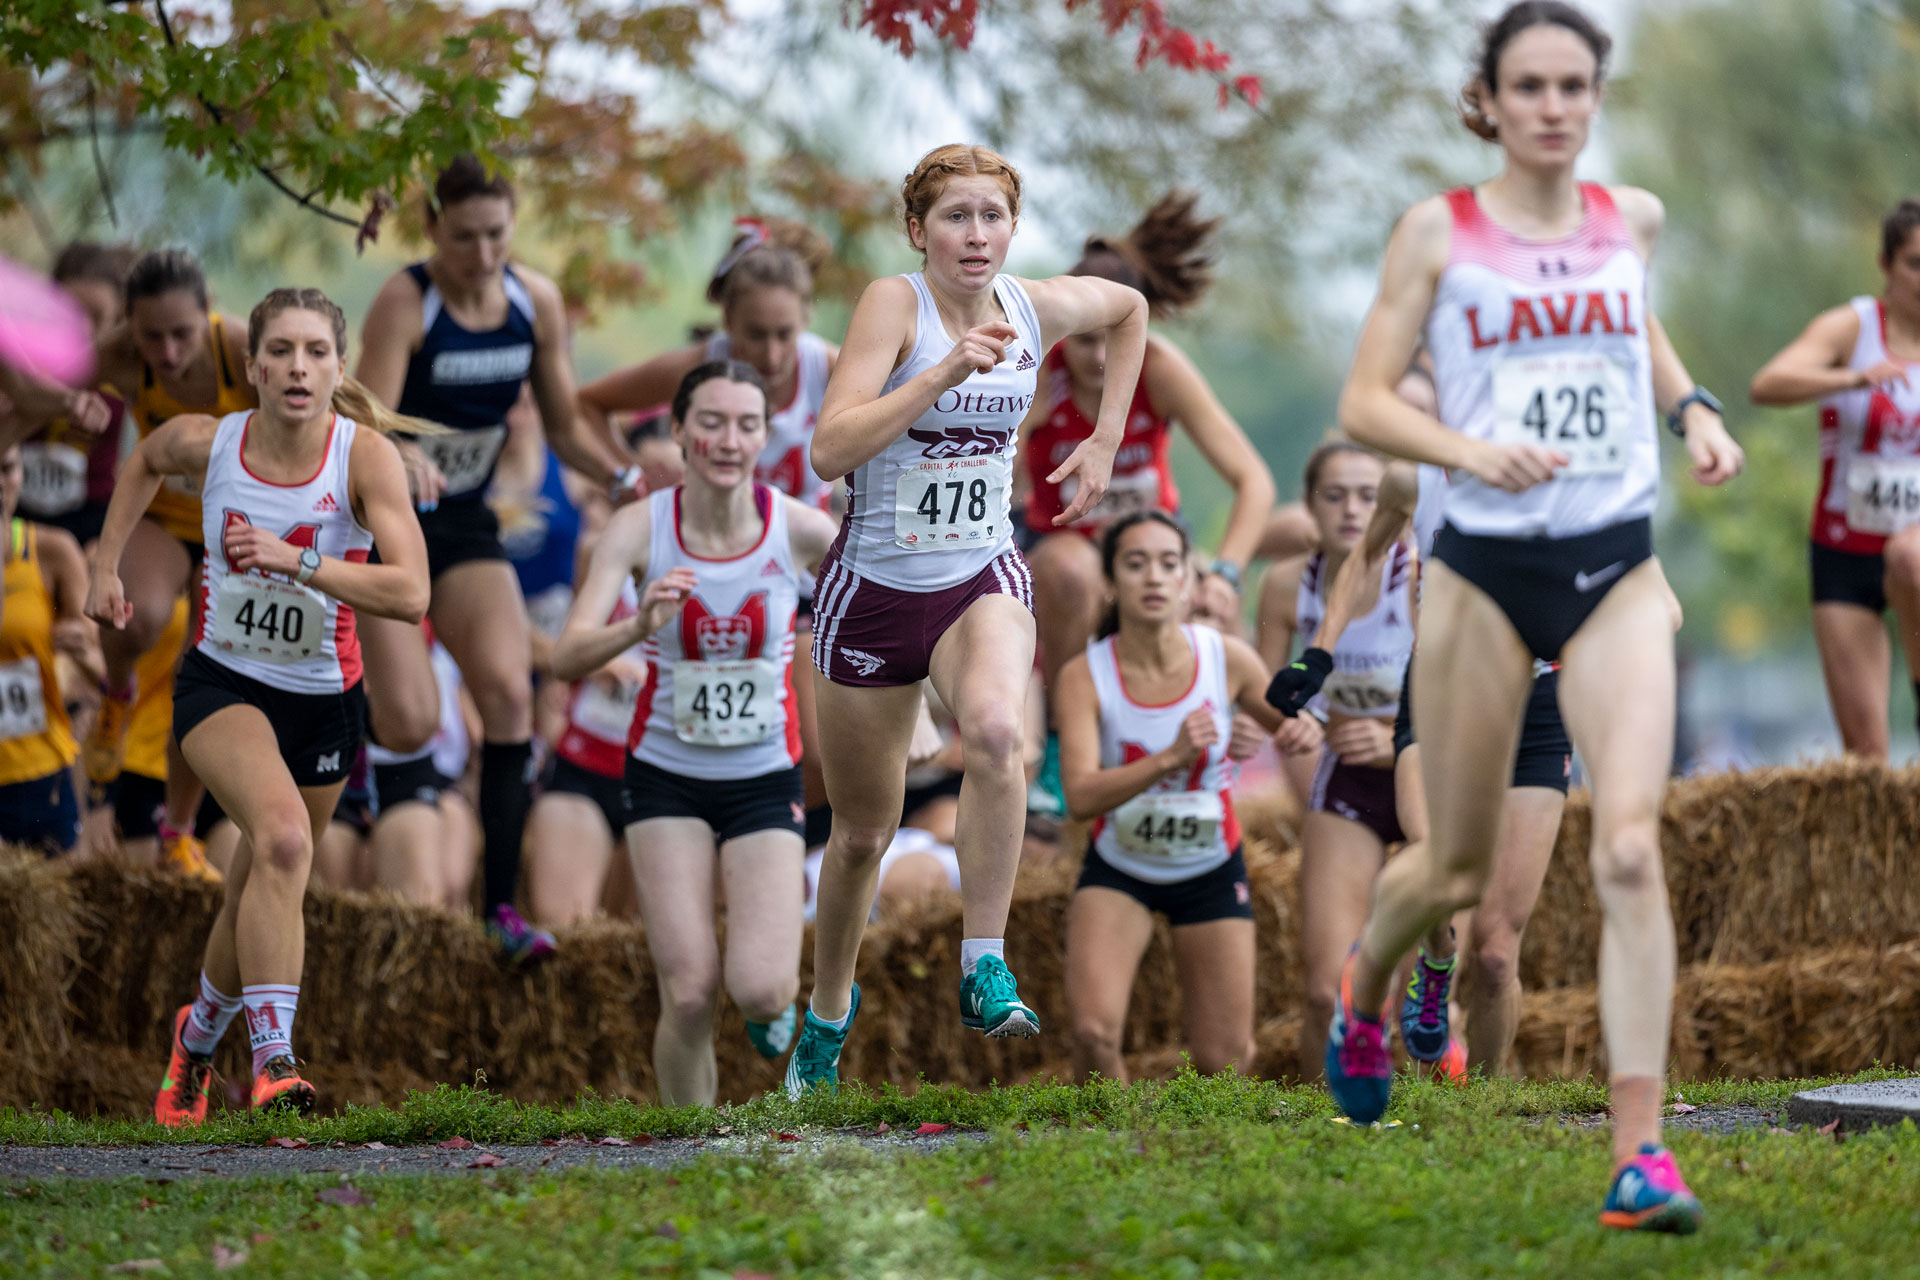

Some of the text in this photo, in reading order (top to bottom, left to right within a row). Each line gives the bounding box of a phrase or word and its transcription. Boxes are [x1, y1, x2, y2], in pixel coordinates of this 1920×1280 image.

[1465, 290, 1638, 350] LAVAL
[1015, 360, 1036, 372] adidas
[1523, 385, 1606, 439] 426
[920, 459, 988, 475] CAPITAL CHALLENGE
[917, 478, 987, 525] 478
[235, 598, 304, 643] 440
[693, 682, 756, 721] 432
[1134, 815, 1199, 843] 445
